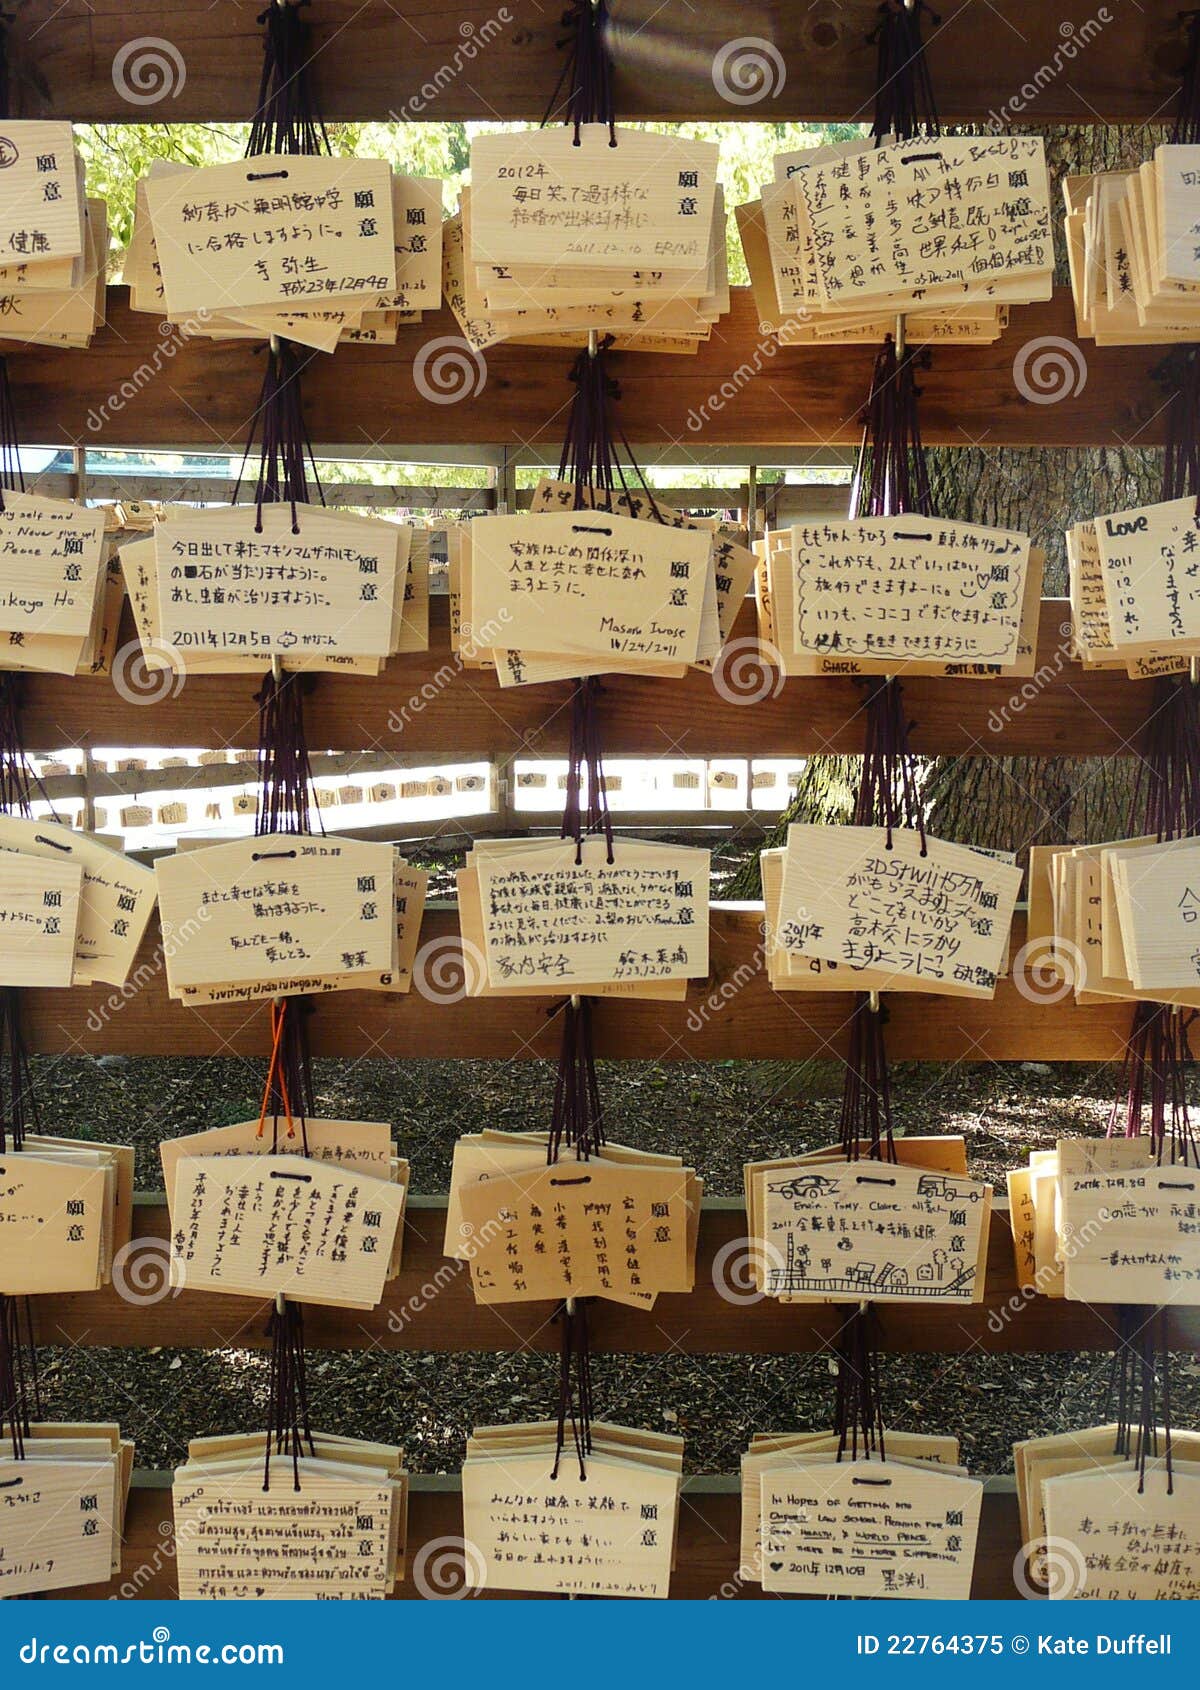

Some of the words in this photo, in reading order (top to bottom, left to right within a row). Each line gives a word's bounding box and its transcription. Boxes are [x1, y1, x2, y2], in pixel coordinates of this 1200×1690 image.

[498, 164, 550, 179] 2012年
[913, 168, 930, 182] All
[938, 158, 964, 174] the
[1105, 516, 1149, 537] Love
[172, 631, 271, 648] 2011年12月5日
